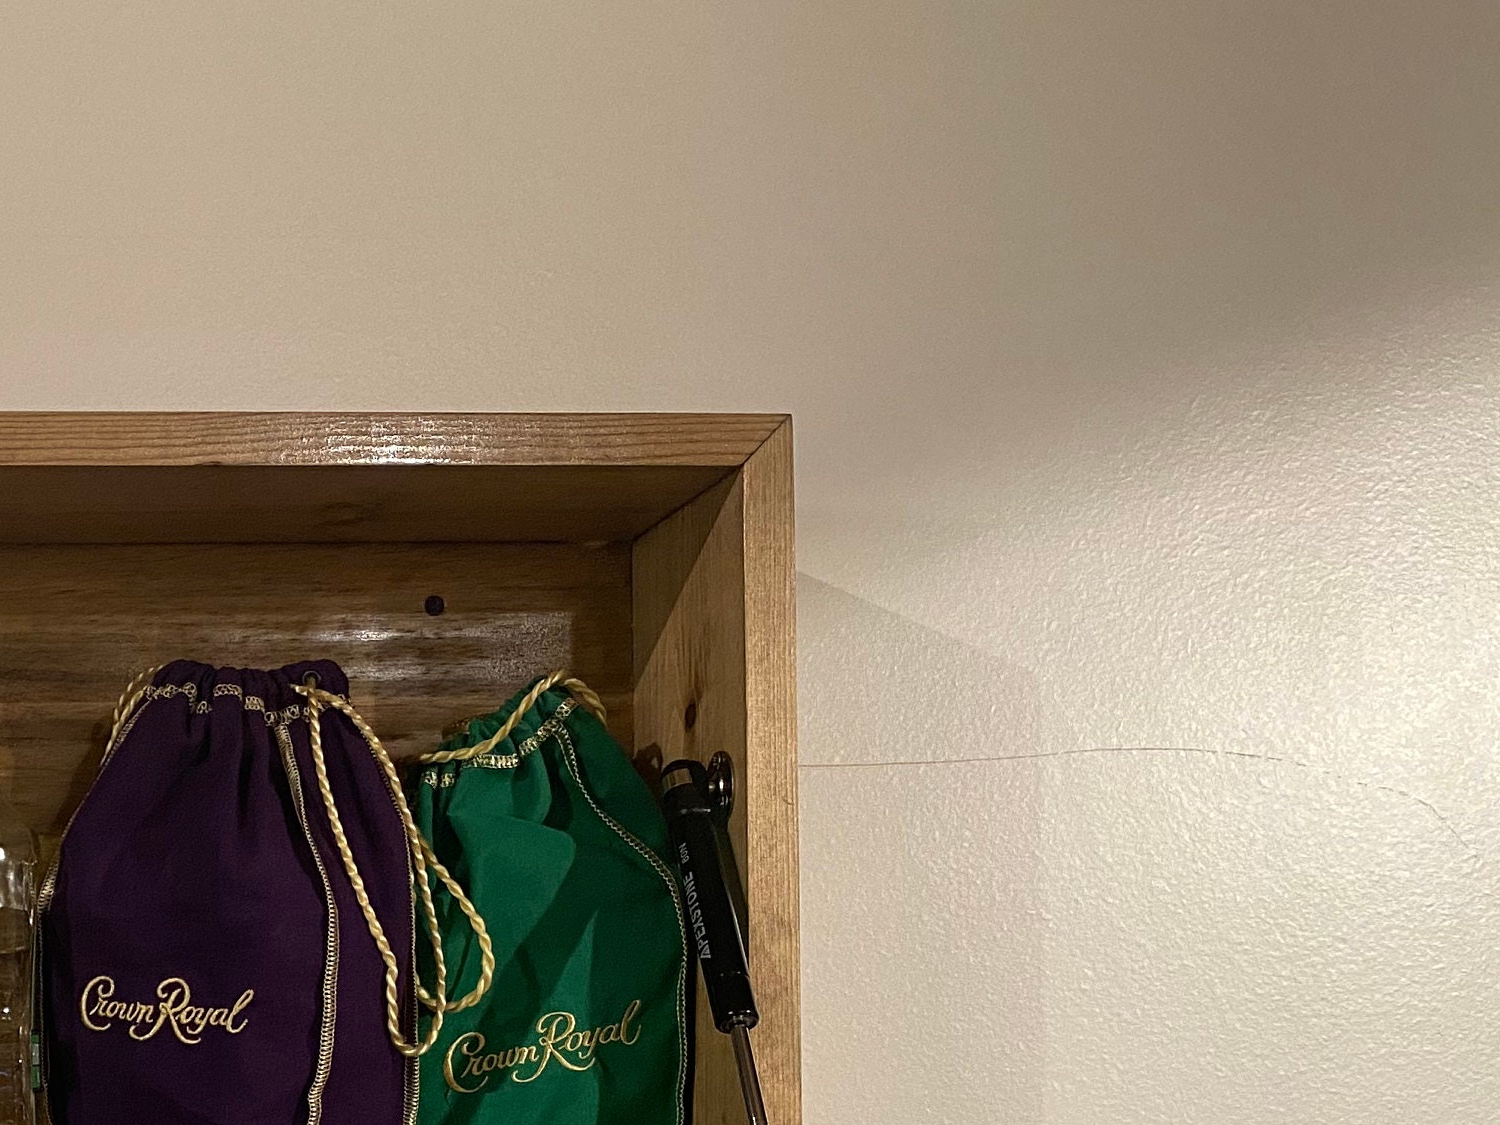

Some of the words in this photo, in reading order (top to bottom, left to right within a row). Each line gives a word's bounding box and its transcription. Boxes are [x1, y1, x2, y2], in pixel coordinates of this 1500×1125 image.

[80, 975, 154, 1031] Crown
[128, 977, 255, 1045] Royal
[443, 1031, 540, 1094] Crown
[511, 999, 642, 1084] Royal
